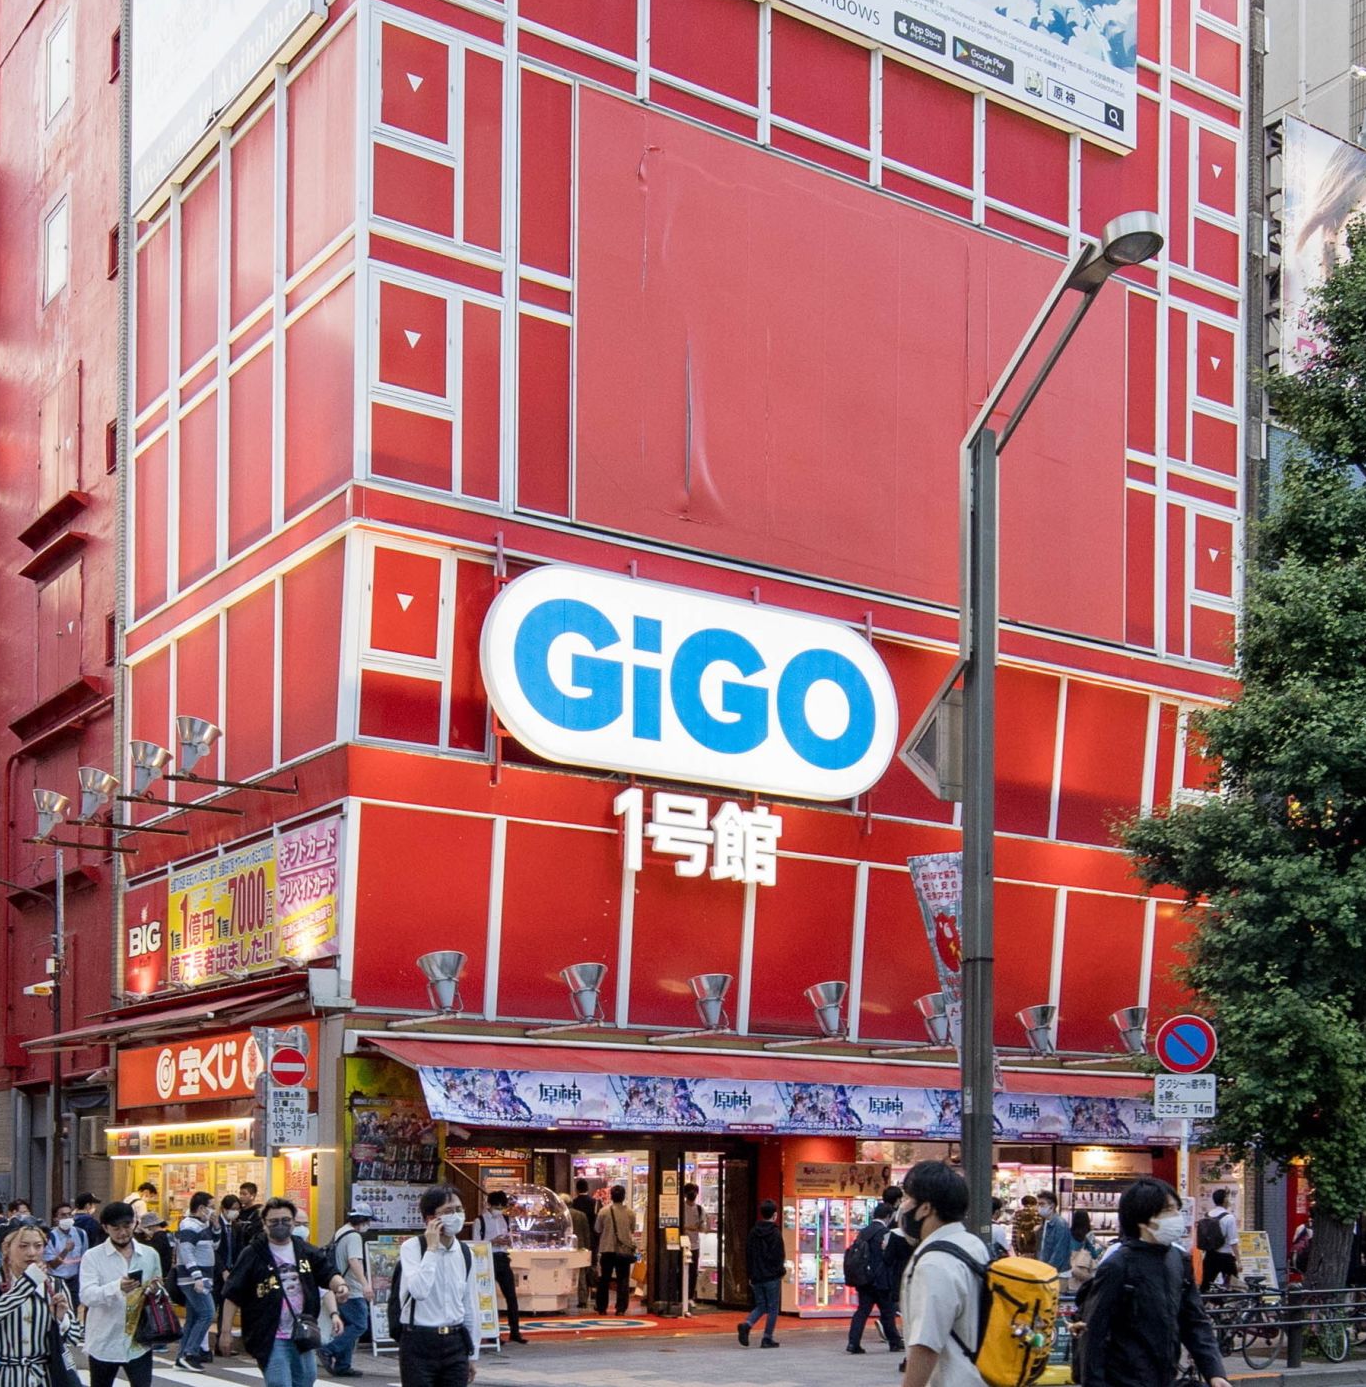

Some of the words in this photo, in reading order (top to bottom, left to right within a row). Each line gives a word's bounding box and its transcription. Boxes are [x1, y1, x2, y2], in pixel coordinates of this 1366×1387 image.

[513, 597, 877, 772] GiGO
[612, 787, 783, 888] 1号館
[127, 919, 162, 959] BIG
[178, 1039, 238, 1097] 宝くじ
[538, 1078, 583, 1109] 原神
[712, 1084, 753, 1113] 原神
[868, 1093, 904, 1116] 原神
[1157, 1103, 1188, 1115] ここから
[1193, 1103, 1213, 1115] 14m
[1008, 1101, 1040, 1122] 原神
